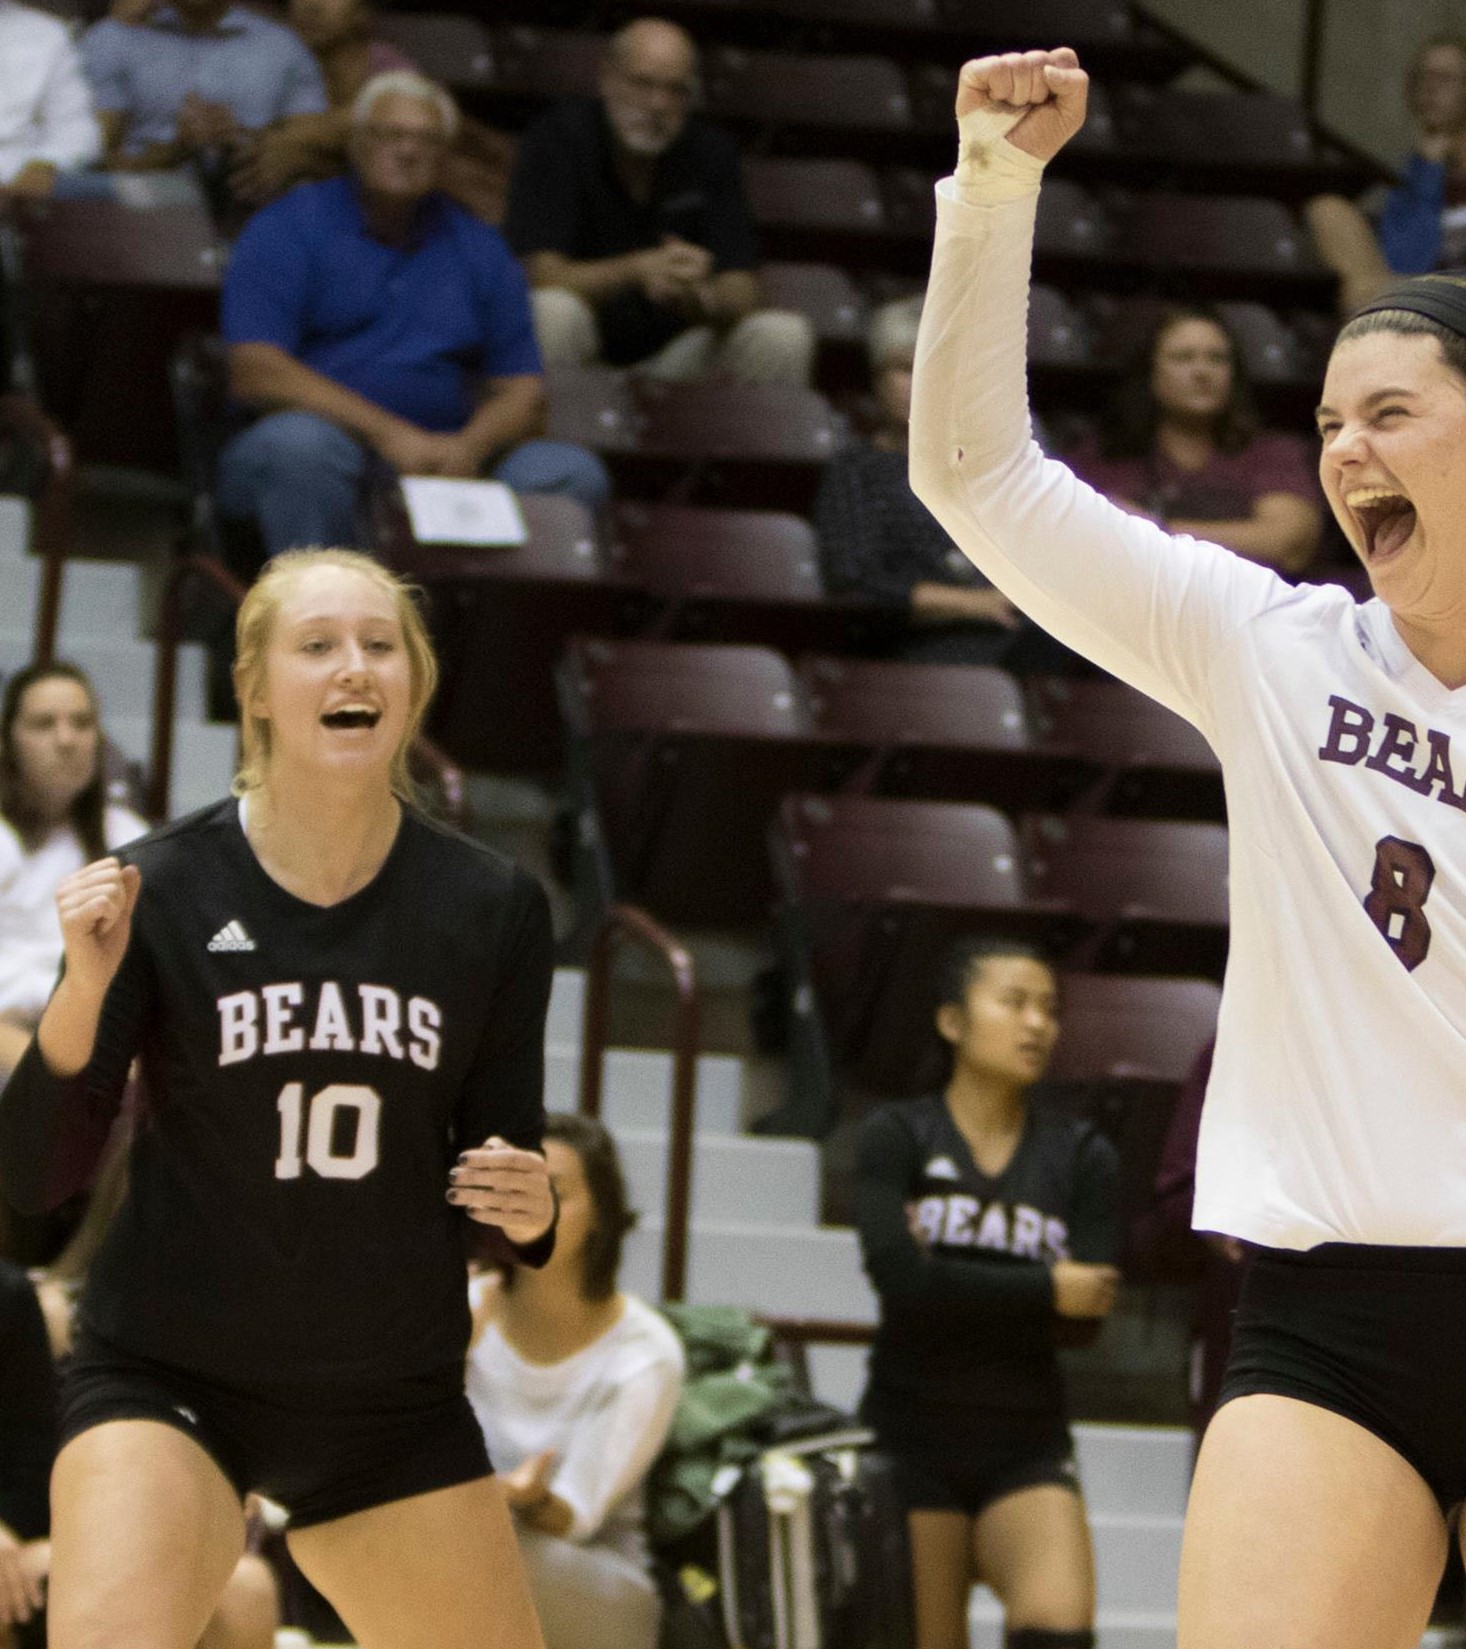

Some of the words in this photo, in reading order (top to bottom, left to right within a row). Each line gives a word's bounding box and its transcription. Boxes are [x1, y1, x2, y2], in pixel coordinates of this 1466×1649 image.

[1363, 834, 1436, 973] 8
[216, 981, 442, 1071] BEARS
[275, 1082, 381, 1180] 10
